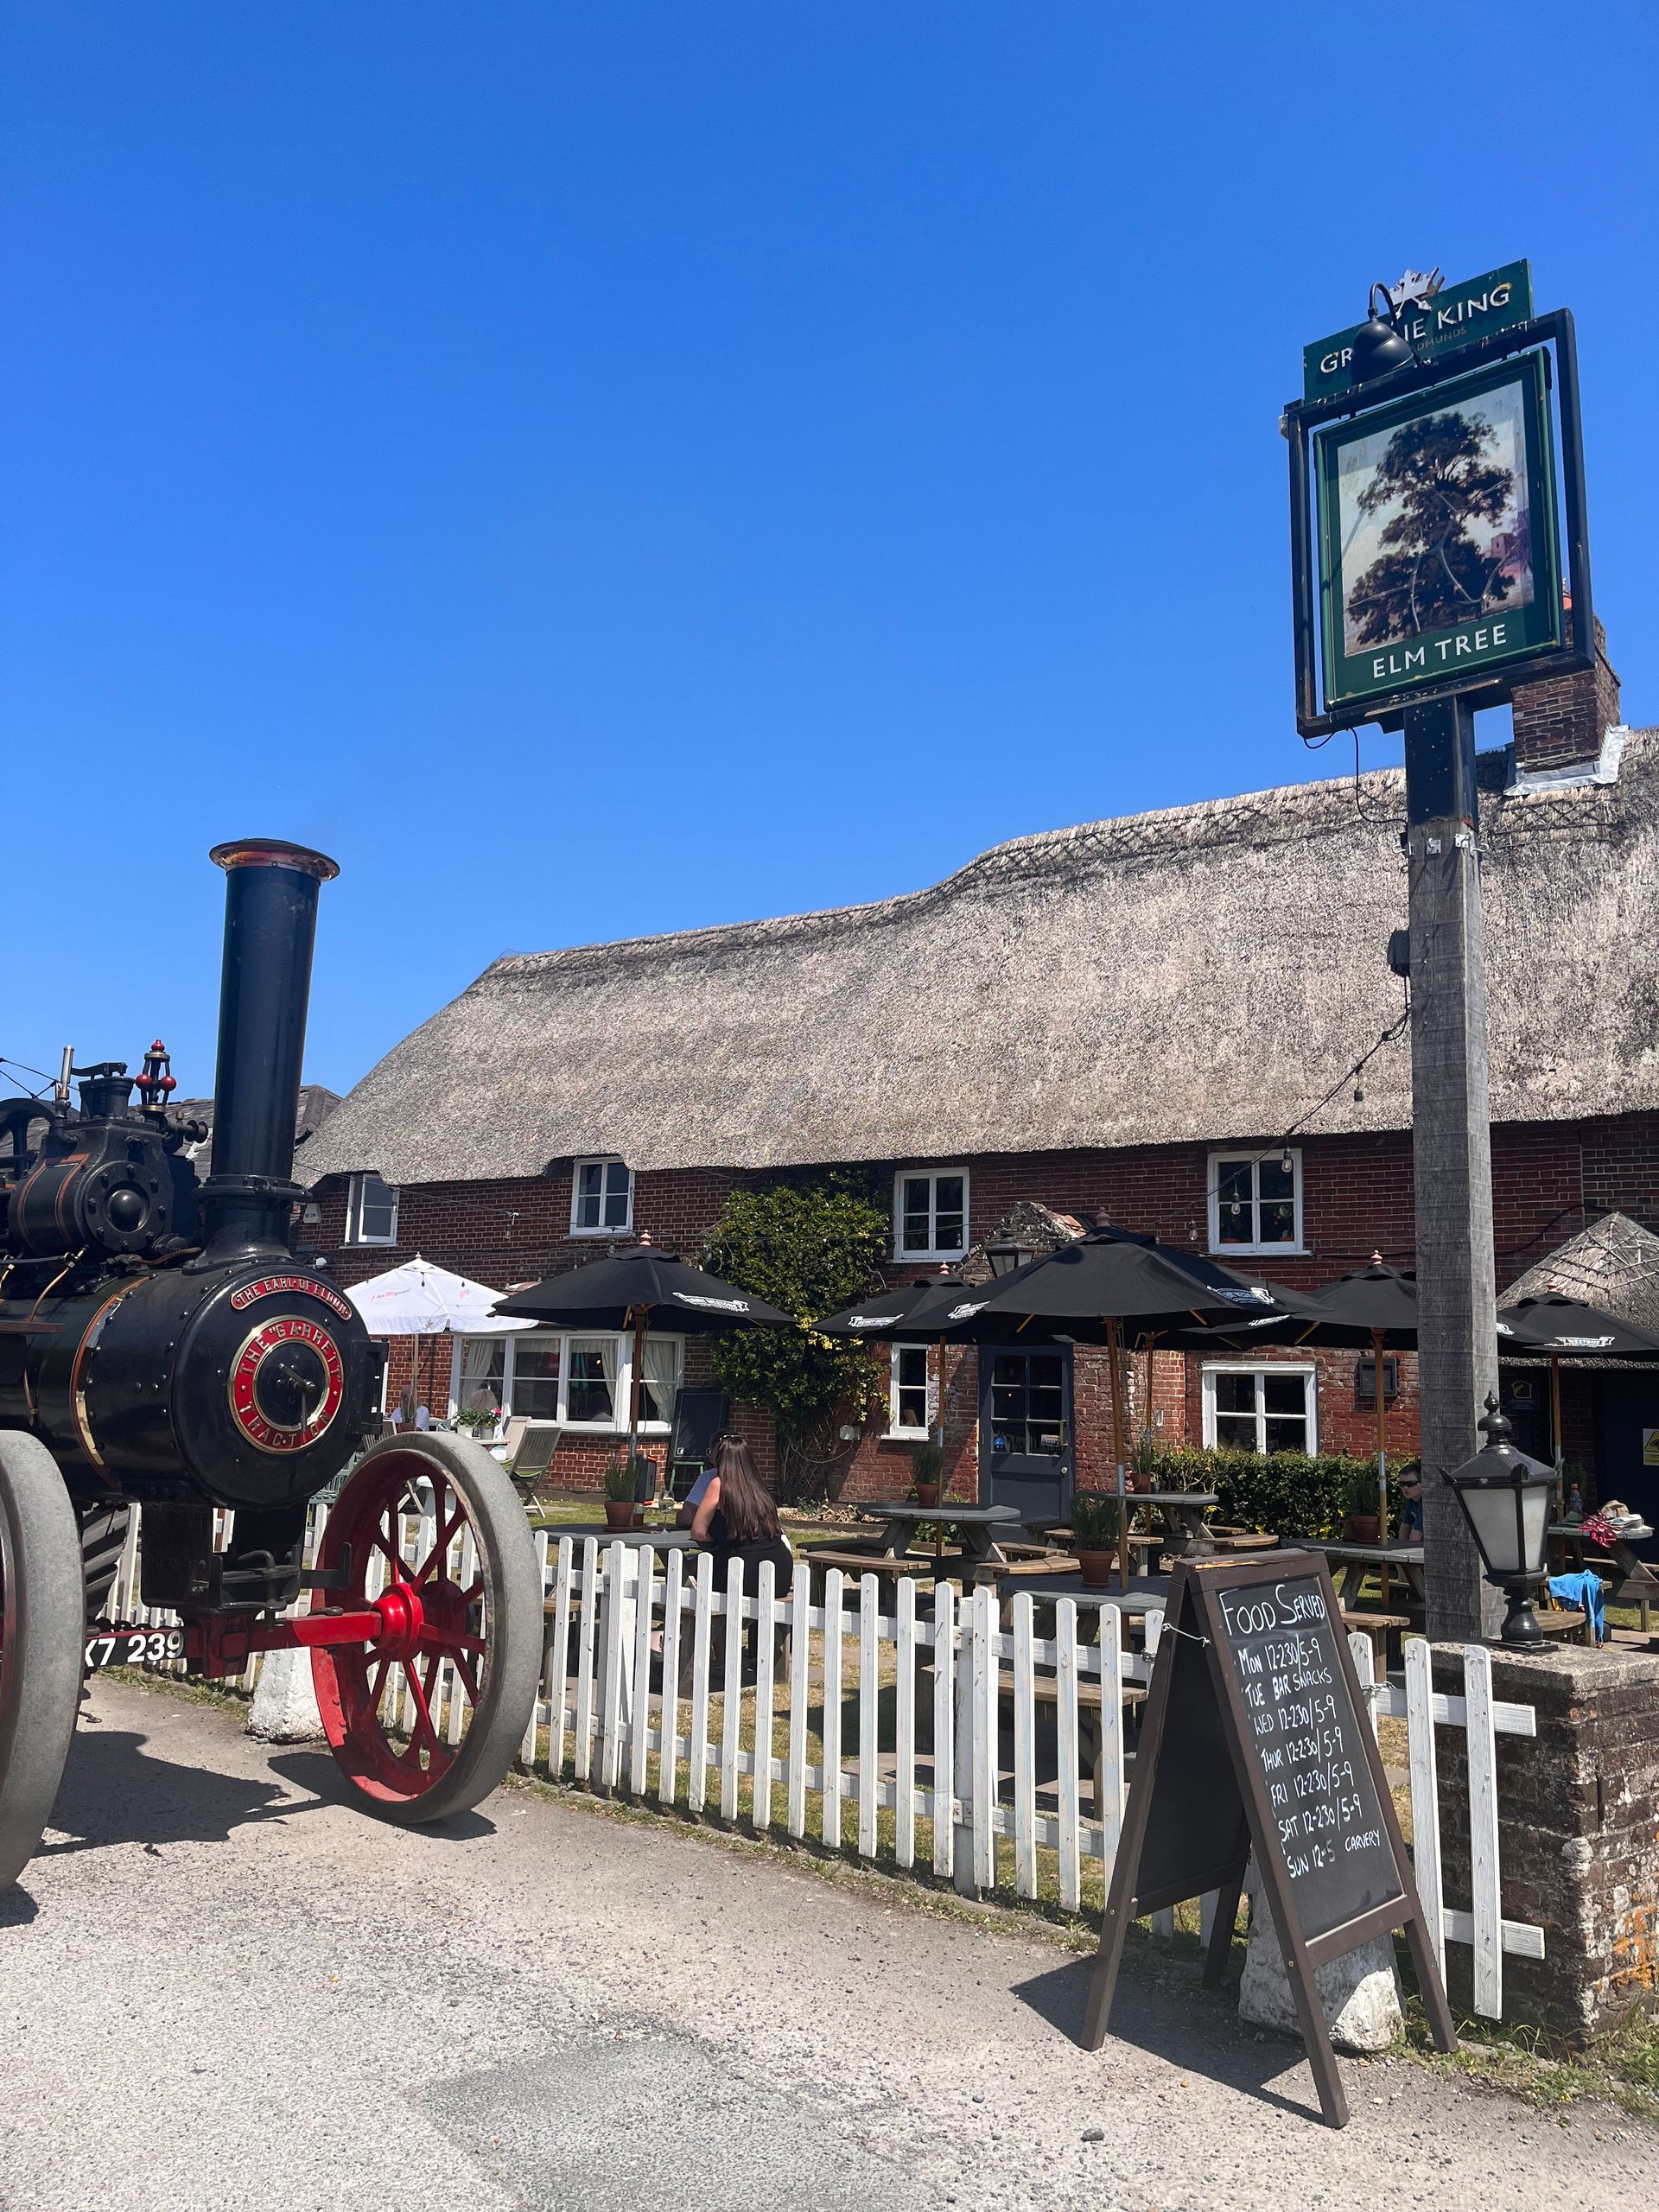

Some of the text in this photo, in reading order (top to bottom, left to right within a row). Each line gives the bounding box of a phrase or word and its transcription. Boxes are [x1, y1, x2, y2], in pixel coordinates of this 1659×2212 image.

[1319, 283, 1510, 373] GRE KING
[1372, 623, 1507, 678] ELM TREE
[237, 1285, 261, 1304] THE
[264, 1277, 295, 1292] EARL
[299, 1279, 312, 1291] OF
[238, 1334, 270, 1376] THE
[239, 1401, 331, 1447] TRACTION
[1219, 1584, 1325, 1636] FOOD SERVED
[127, 1630, 184, 1662] 239
[1237, 1648, 1262, 1675] MON
[1244, 1667, 1332, 1707] TUE BAR SNACKS
[1254, 1713, 1274, 1735] WED
[1261, 1748, 1284, 1772] THUR
[1270, 1783, 1288, 1808] FRI
[1278, 1815, 1299, 1842] SAT
[1287, 1828, 1380, 1878] SUN 12-5 CARVERY
